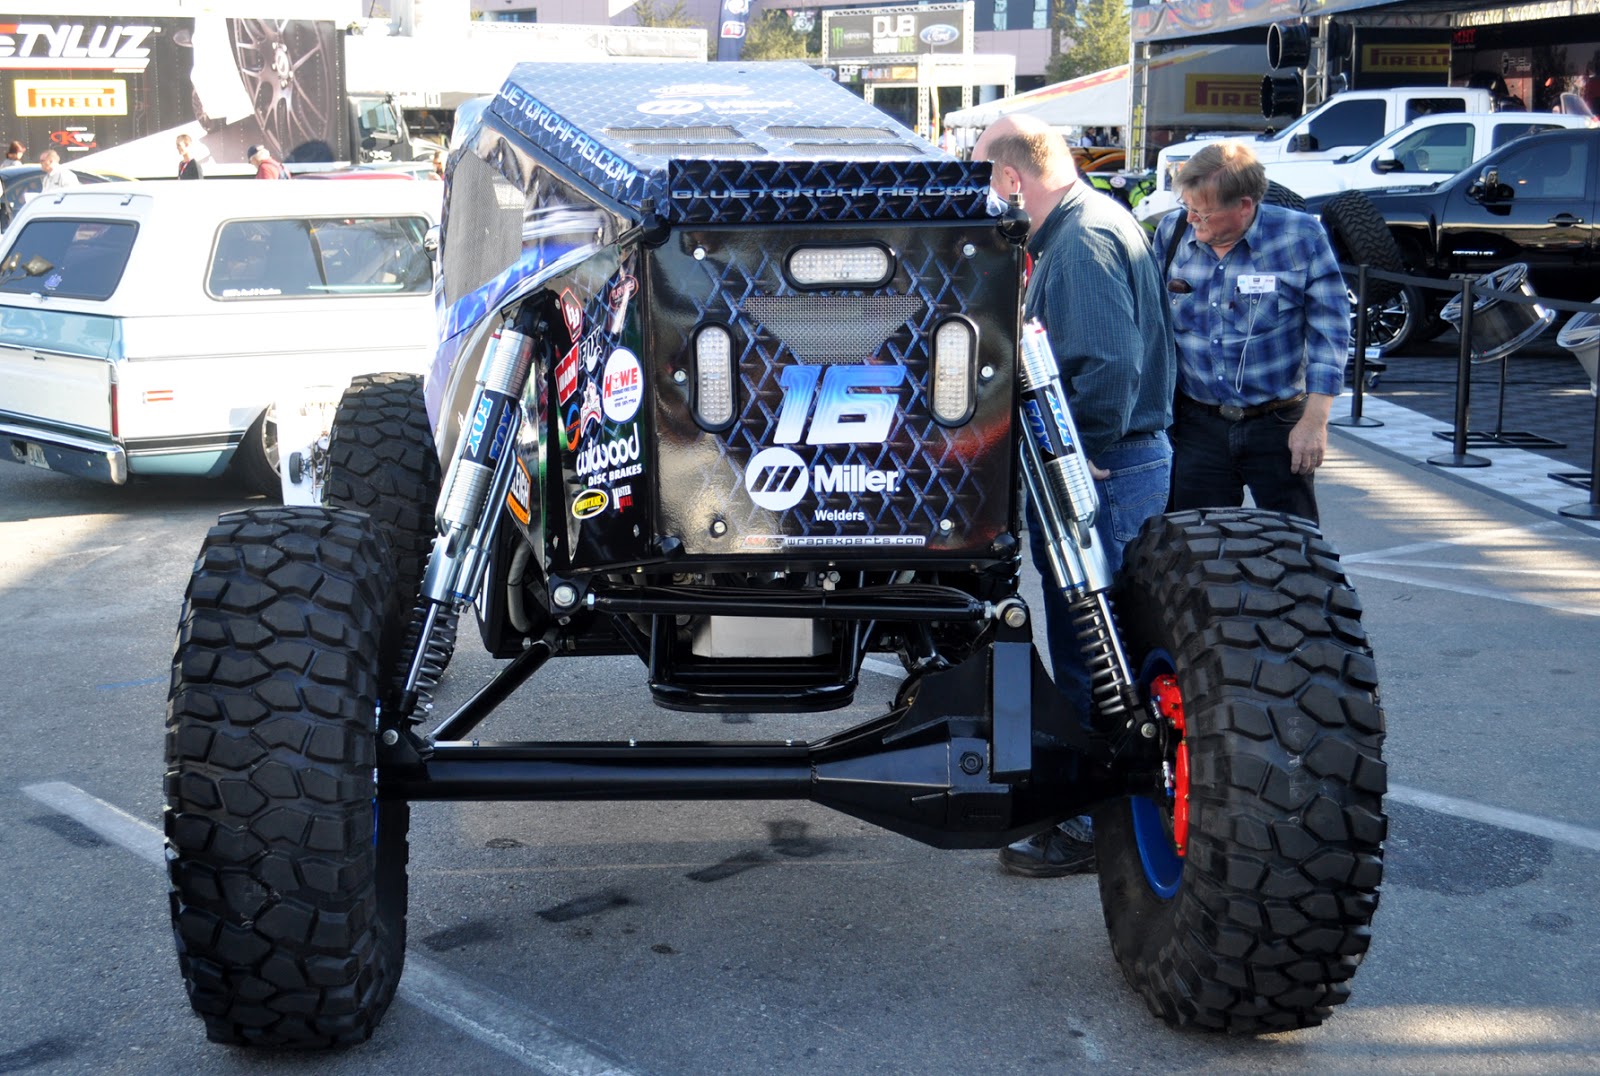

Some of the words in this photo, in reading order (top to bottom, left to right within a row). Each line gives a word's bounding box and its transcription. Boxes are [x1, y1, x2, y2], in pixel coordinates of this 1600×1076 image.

[873, 15, 914, 38] DUB
[1371, 48, 1450, 65] PIRELLI
[28, 88, 115, 108] PIRELLI
[1195, 81, 1261, 106] PIRE
[773, 365, 907, 445] 16
[468, 395, 494, 458] FOX
[1024, 399, 1055, 455] FOX
[576, 422, 640, 477] wilwood
[588, 474, 607, 487] DISC
[609, 463, 642, 480] BRAKES
[814, 509, 865, 522] Welders
[786, 536, 924, 547] wrapexperts.com
